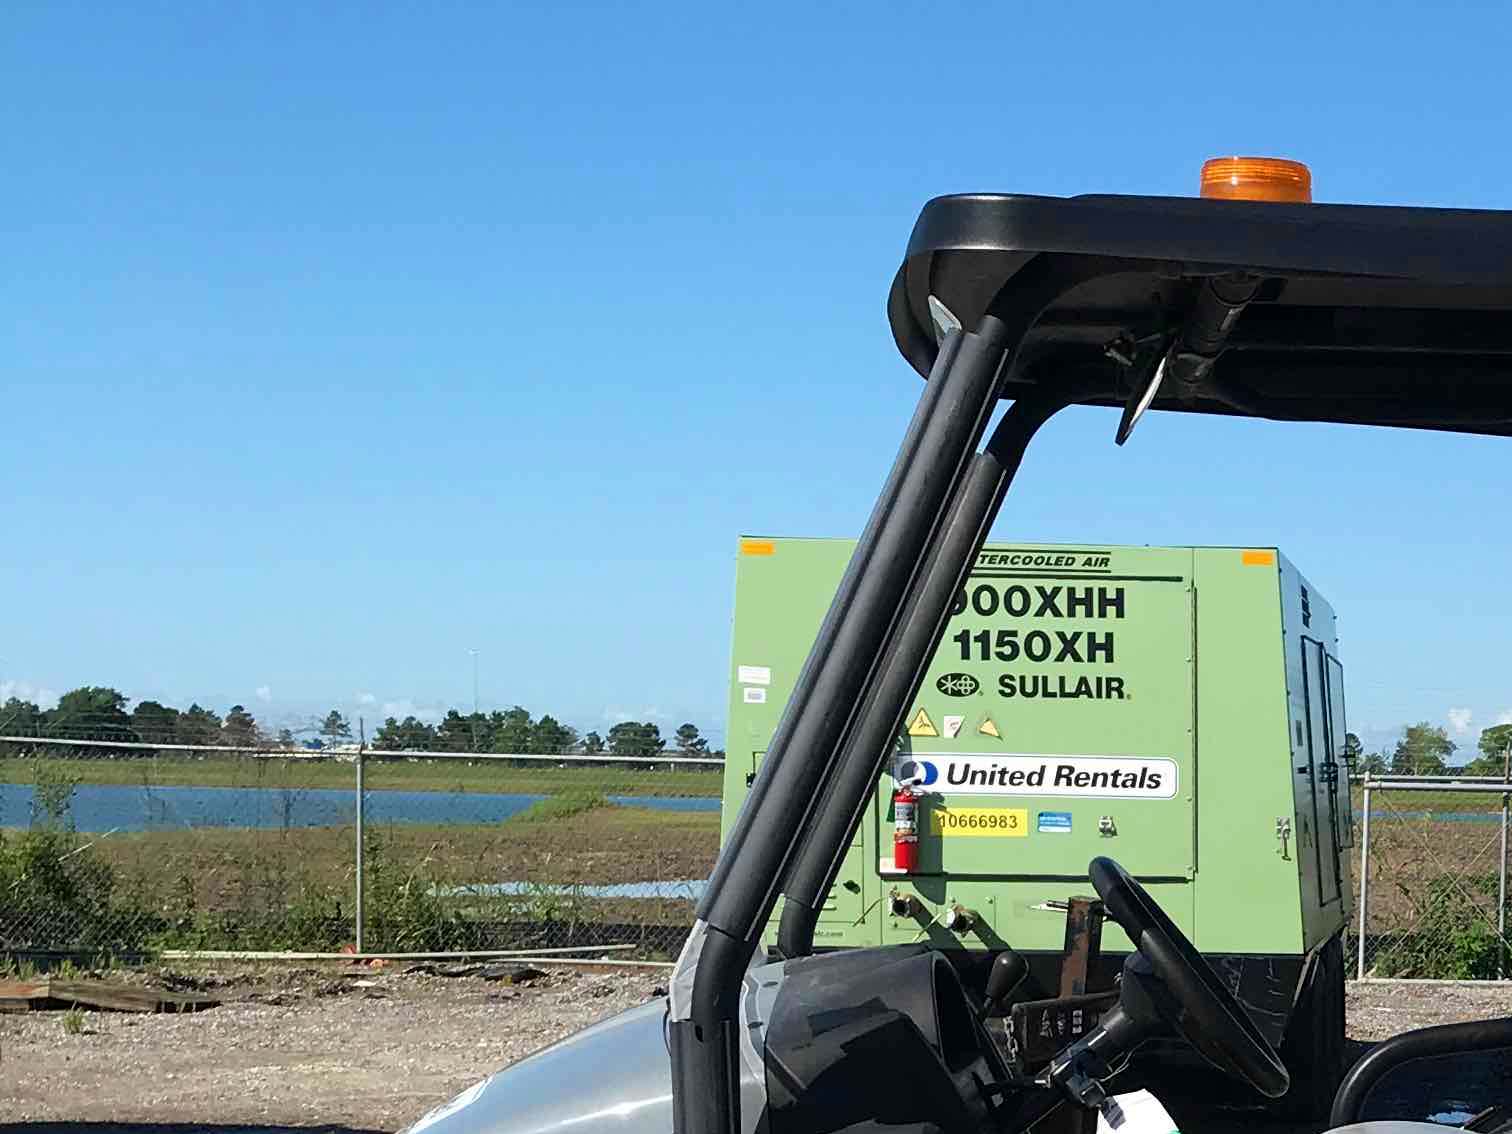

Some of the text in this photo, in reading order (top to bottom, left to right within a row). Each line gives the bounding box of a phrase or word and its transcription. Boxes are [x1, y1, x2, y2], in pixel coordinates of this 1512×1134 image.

[1081, 556, 1110, 567] AIR
[953, 629, 1114, 663] 1150XH
[998, 674, 1125, 700] SULLAIR
[947, 763, 1163, 790] United Rentals
[937, 814, 1018, 829] 10666983
